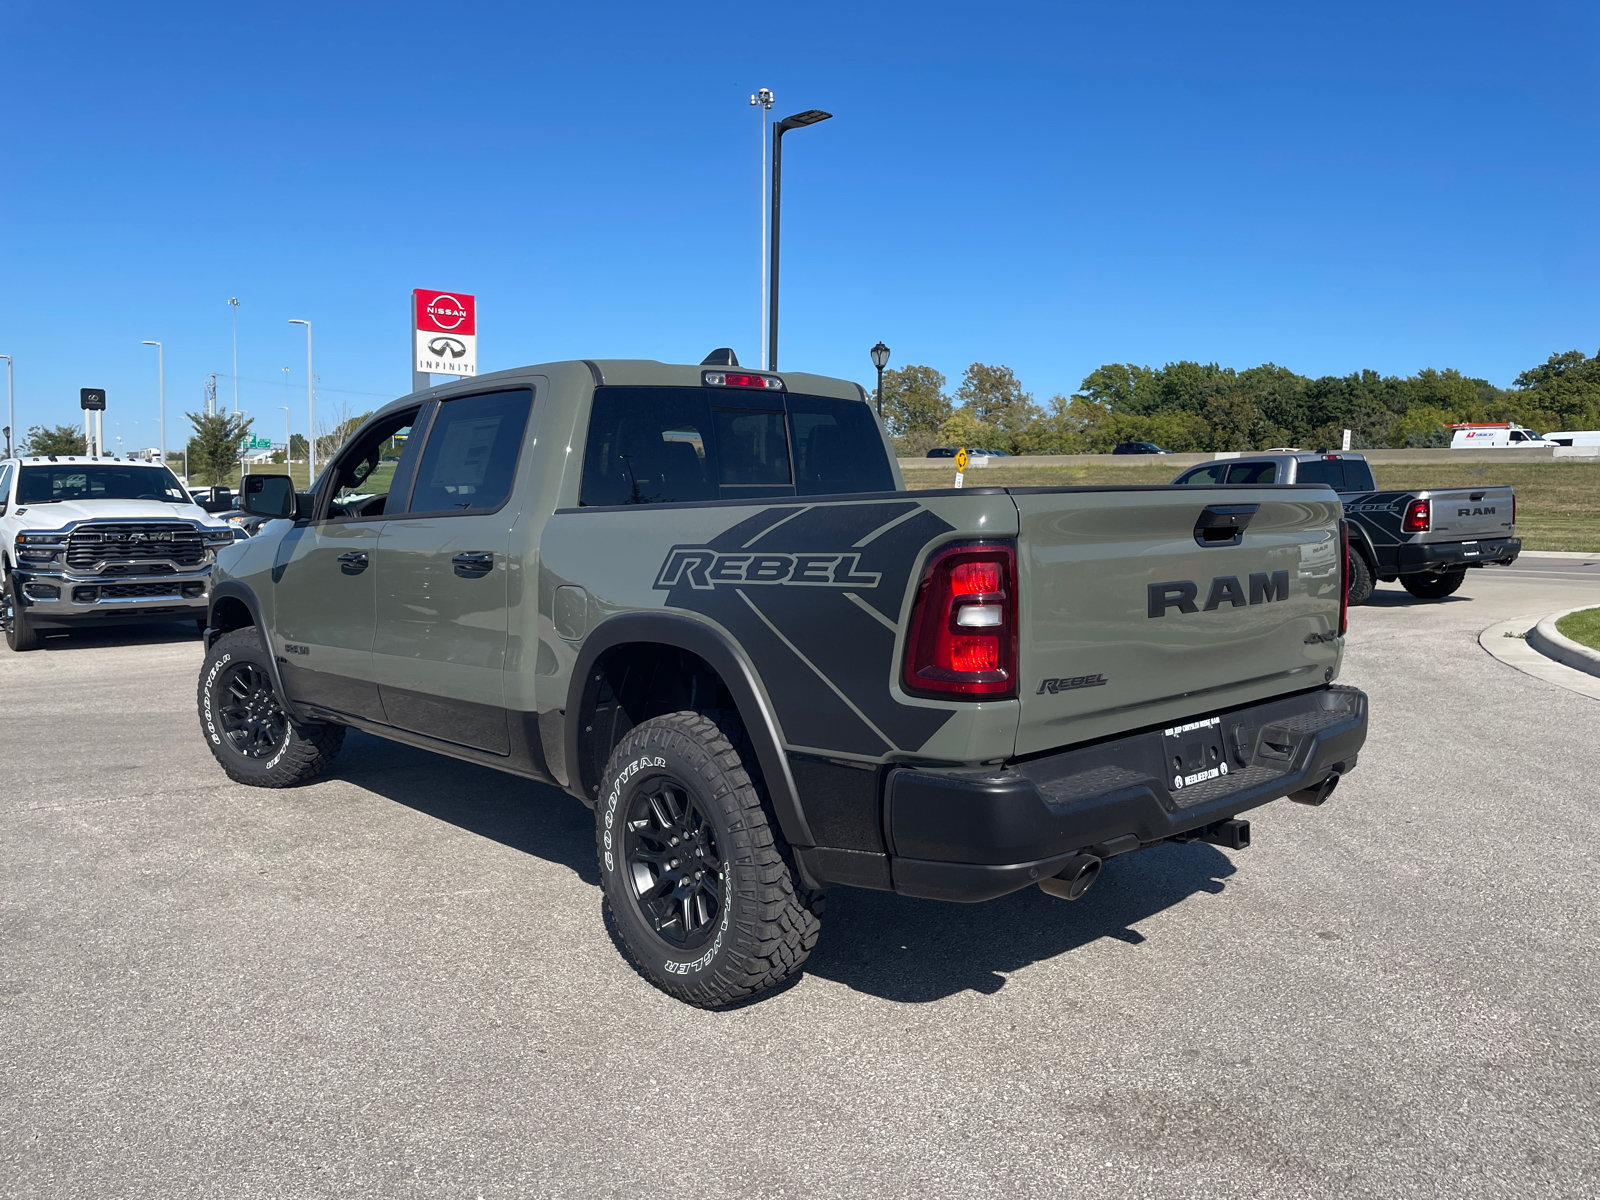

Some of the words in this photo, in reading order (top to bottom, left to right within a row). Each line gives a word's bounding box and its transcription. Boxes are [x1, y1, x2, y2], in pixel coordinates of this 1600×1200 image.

[427, 306, 466, 317] NISSAN
[420, 360, 474, 372] INFINITI
[1342, 503, 1399, 513] REBEL
[1457, 507, 1496, 517] RAM
[105, 532, 171, 541] RAM
[655, 548, 883, 590] REBEL
[1147, 569, 1290, 618] RAM
[1036, 673, 1109, 695] REBEL
[204, 653, 231, 745] GOODYEAR
[603, 756, 667, 872] GOODYEAR
[664, 861, 732, 975] WRANGLER
